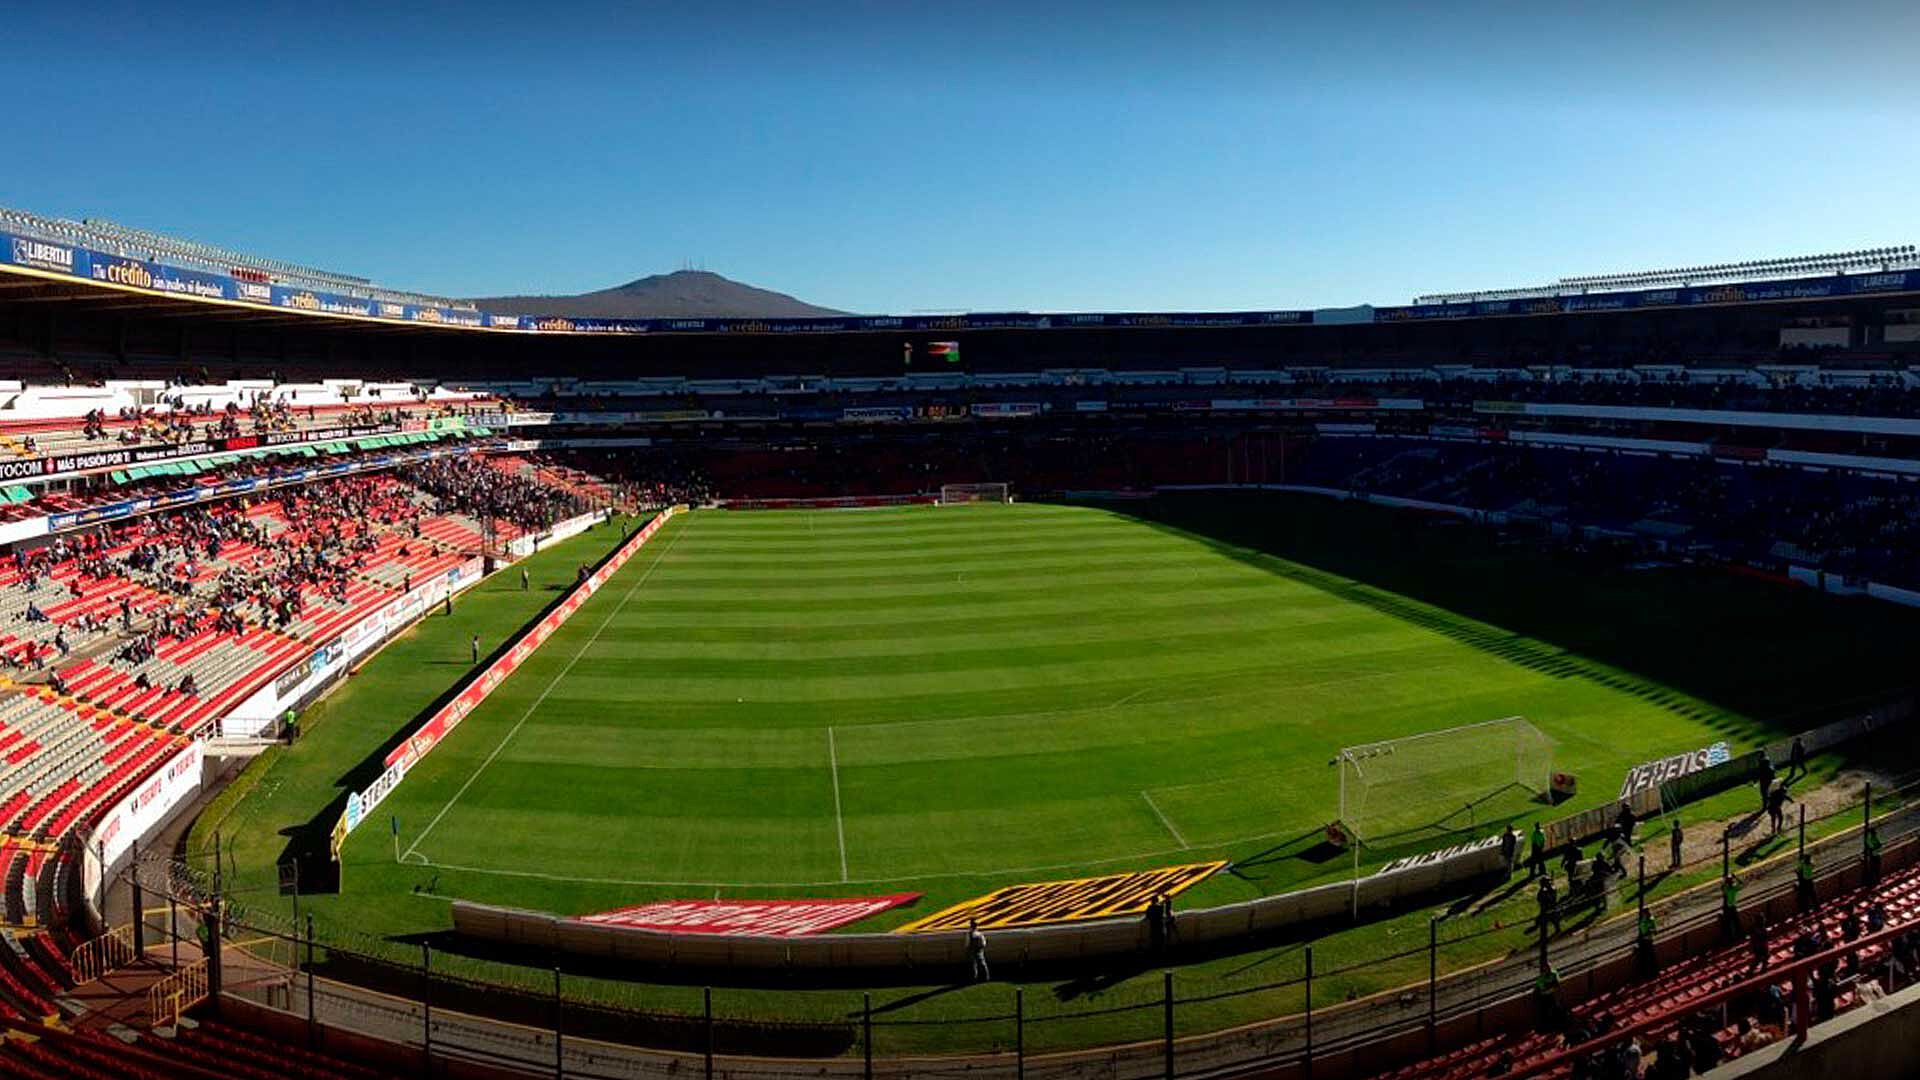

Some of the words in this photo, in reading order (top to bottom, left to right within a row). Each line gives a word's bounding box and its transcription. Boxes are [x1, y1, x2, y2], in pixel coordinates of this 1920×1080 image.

[107, 261, 152, 288] crédito
[539, 319, 575, 331] crédito
[56, 456, 75, 471] MÁS
[361, 767, 399, 814] STEREN
